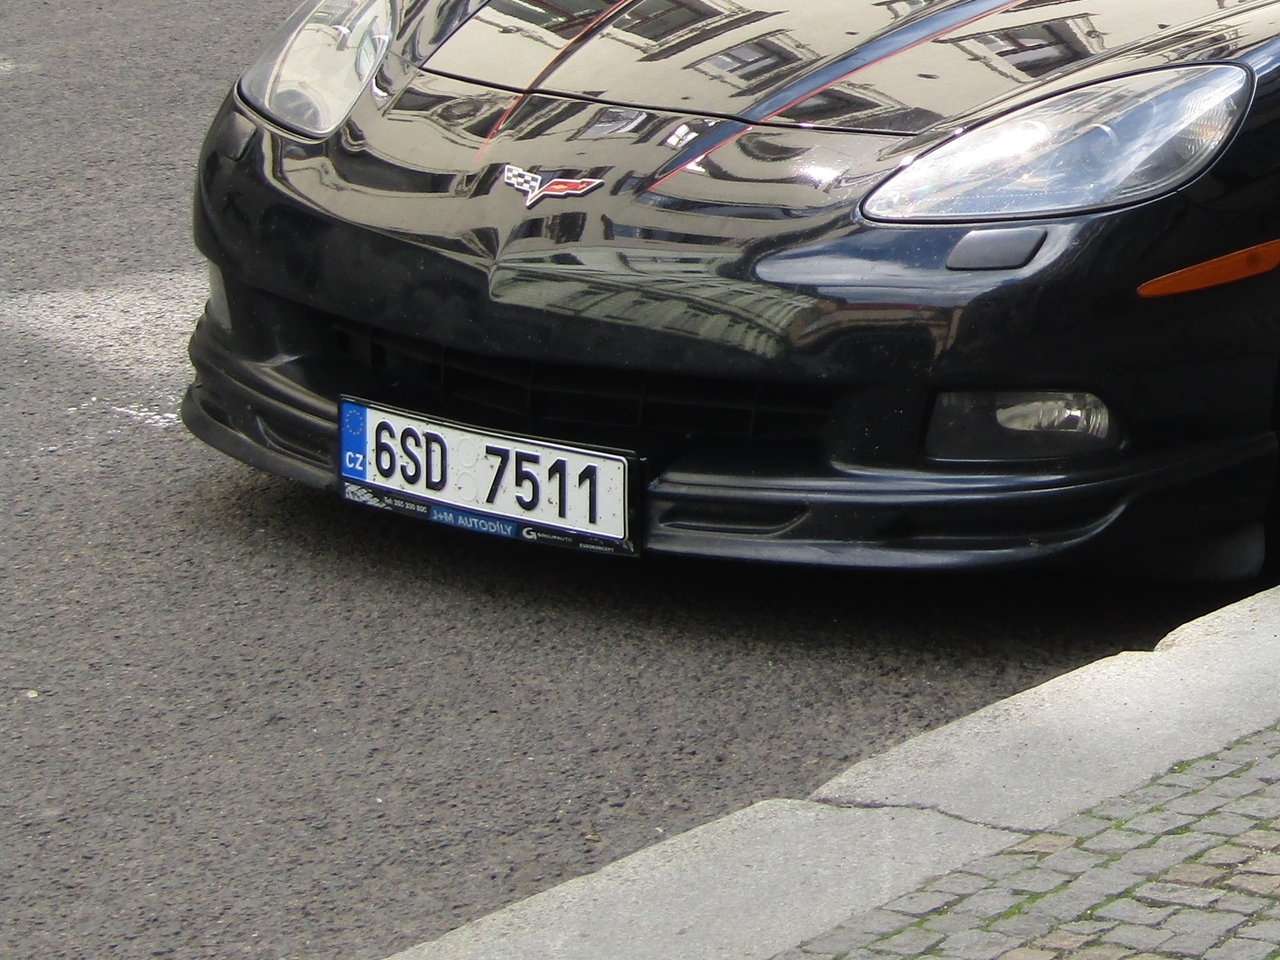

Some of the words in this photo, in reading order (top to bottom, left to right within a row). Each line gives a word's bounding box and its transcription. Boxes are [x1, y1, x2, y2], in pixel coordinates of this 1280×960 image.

[345, 451, 364, 471] CZ
[375, 420, 448, 491] 6SD
[485, 444, 598, 524] 7511
[431, 509, 454, 524] J+M
[457, 515, 513, 536] AUTODÍLY
